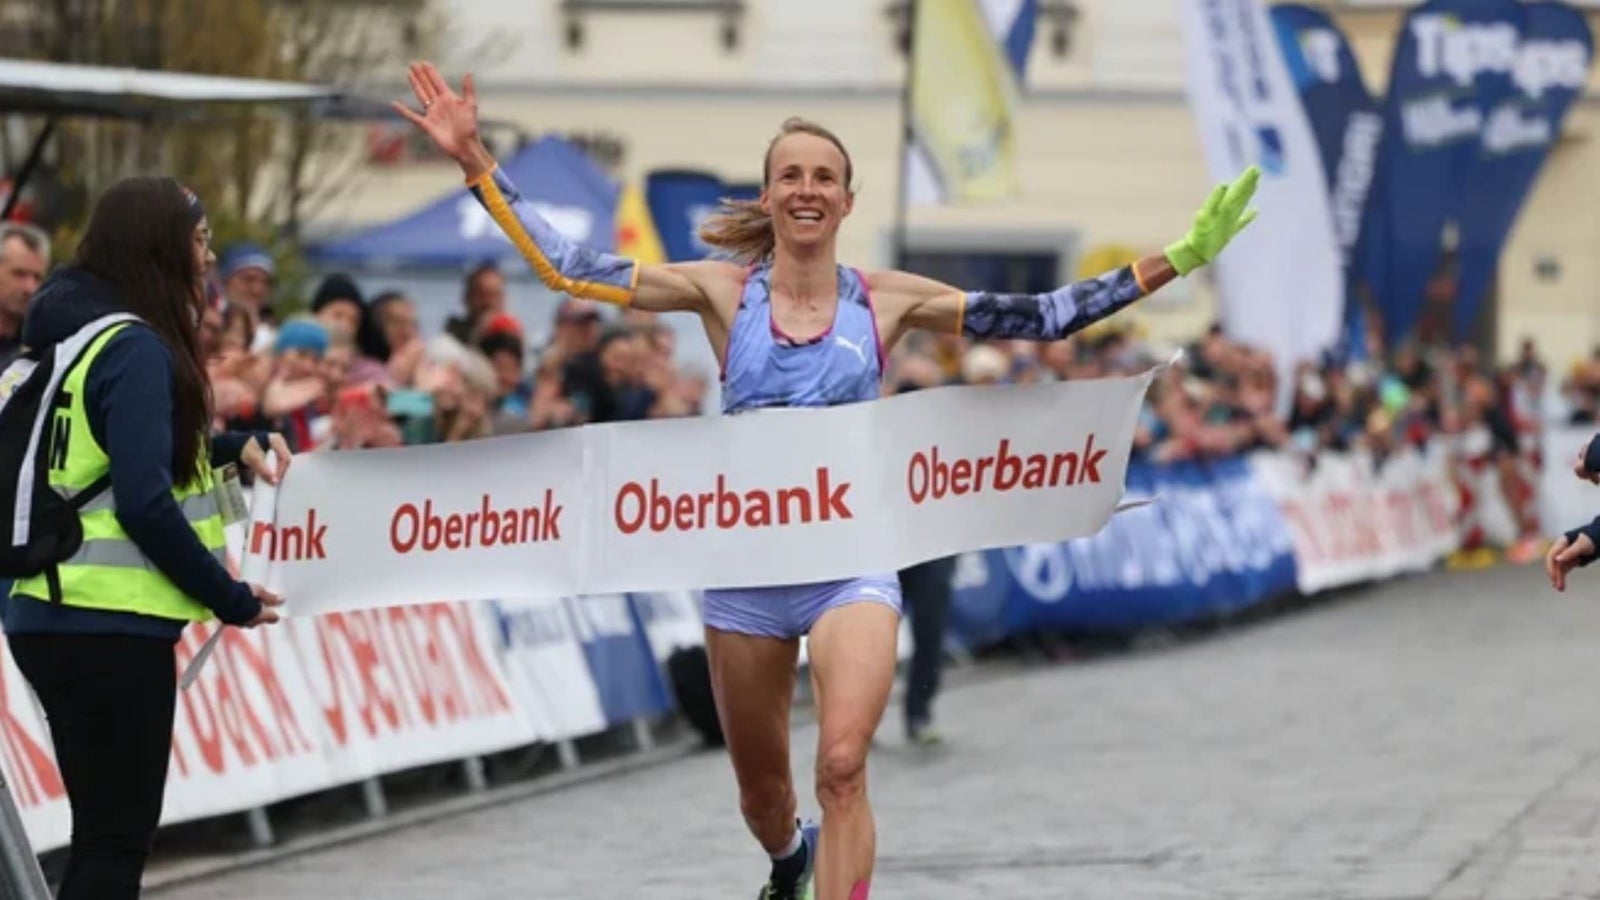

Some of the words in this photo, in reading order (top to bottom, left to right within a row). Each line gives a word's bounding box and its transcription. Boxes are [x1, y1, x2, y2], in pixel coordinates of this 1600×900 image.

[390, 489, 562, 554] Oberbank
[613, 467, 852, 535] Oberbank
[907, 435, 1107, 504] Oberbank
